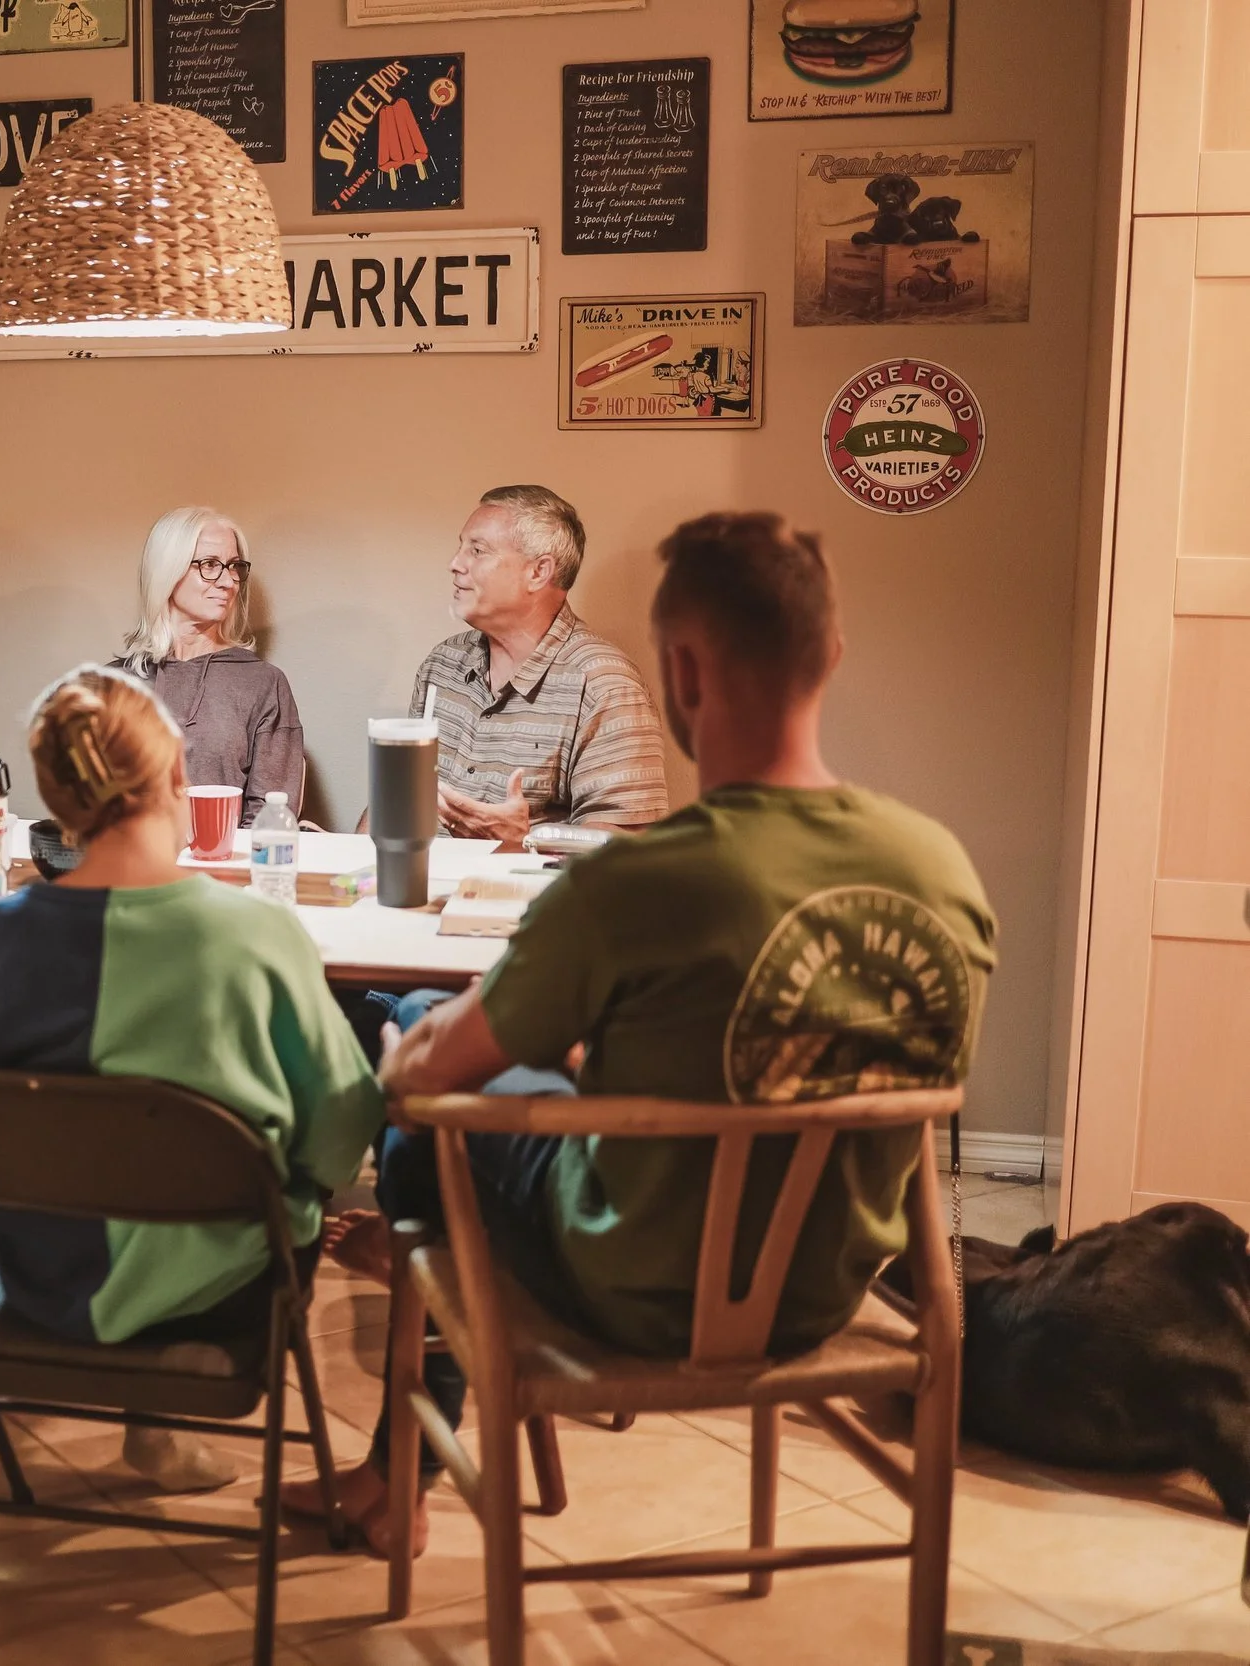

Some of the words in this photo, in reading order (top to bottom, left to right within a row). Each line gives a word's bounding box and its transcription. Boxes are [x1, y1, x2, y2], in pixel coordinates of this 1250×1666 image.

[176, 31, 192, 40] Cup
[194, 28, 203, 42] of
[204, 28, 241, 36] Romance
[176, 43, 198, 53] Pinch
[201, 42, 209, 56] of
[210, 43, 238, 51] Humor
[213, 55, 222, 69] of
[184, 72, 192, 86] of
[194, 70, 247, 84] Compatibility
[367, 60, 409, 103] POPS
[580, 74, 613, 87] Recipe
[617, 73, 634, 84] For
[637, 69, 694, 83] Friendship
[176, 85, 219, 98] Tablespoons
[222, 83, 230, 98] of
[233, 83, 254, 92] Trust
[578, 91, 629, 106] Ingredients:
[760, 97, 783, 108] STOP
[786, 95, 797, 107] IN
[800, 93, 808, 107] &
[865, 92, 890, 104] WITH
[894, 91, 912, 103] THE
[916, 89, 941, 101] BEST!
[193, 99, 201, 111] of
[203, 99, 230, 110] Respect
[585, 110, 602, 118] Pint
[605, 108, 615, 123] of
[618, 109, 640, 117] Trust
[320, 84, 382, 177] SPACE
[584, 124, 604, 133] Dash
[606, 123, 616, 138] of
[618, 124, 646, 135] Caring
[582, 139, 602, 150] Cups
[604, 138, 615, 153] of
[623, 151, 632, 165] of
[634, 149, 664, 159] Shared
[666, 150, 693, 158] Secrets
[581, 170, 598, 180] Cup
[600, 167, 610, 182] of
[611, 166, 645, 176] Mutual
[647, 164, 687, 180] Affection
[331, 200, 341, 210] 7
[340, 169, 372, 201] Flavors
[619, 182, 629, 197] of
[630, 183, 662, 194] Respect
[582, 199, 592, 208] lbs
[595, 198, 605, 213] of
[609, 199, 646, 207] Common
[648, 197, 686, 206] Interests
[574, 216, 580, 224] 3
[624, 213, 633, 227] of
[635, 212, 675, 226] Listening
[577, 230, 594, 240] and
[604, 230, 619, 243] Bag
[622, 229, 632, 244] of
[286, 254, 511, 330] ARKET
[576, 308, 623, 324] Mike's
[838, 366, 902, 414] PURE
[914, 367, 973, 421] FOOD
[606, 397, 634, 415] HOT
[636, 396, 678, 415] DOGS
[887, 394, 922, 415] 57
[922, 400, 940, 408] 1869
[864, 429, 943, 448] HEINZ
[865, 462, 940, 475] VARIETIES
[842, 465, 962, 505] PRODUCTS
